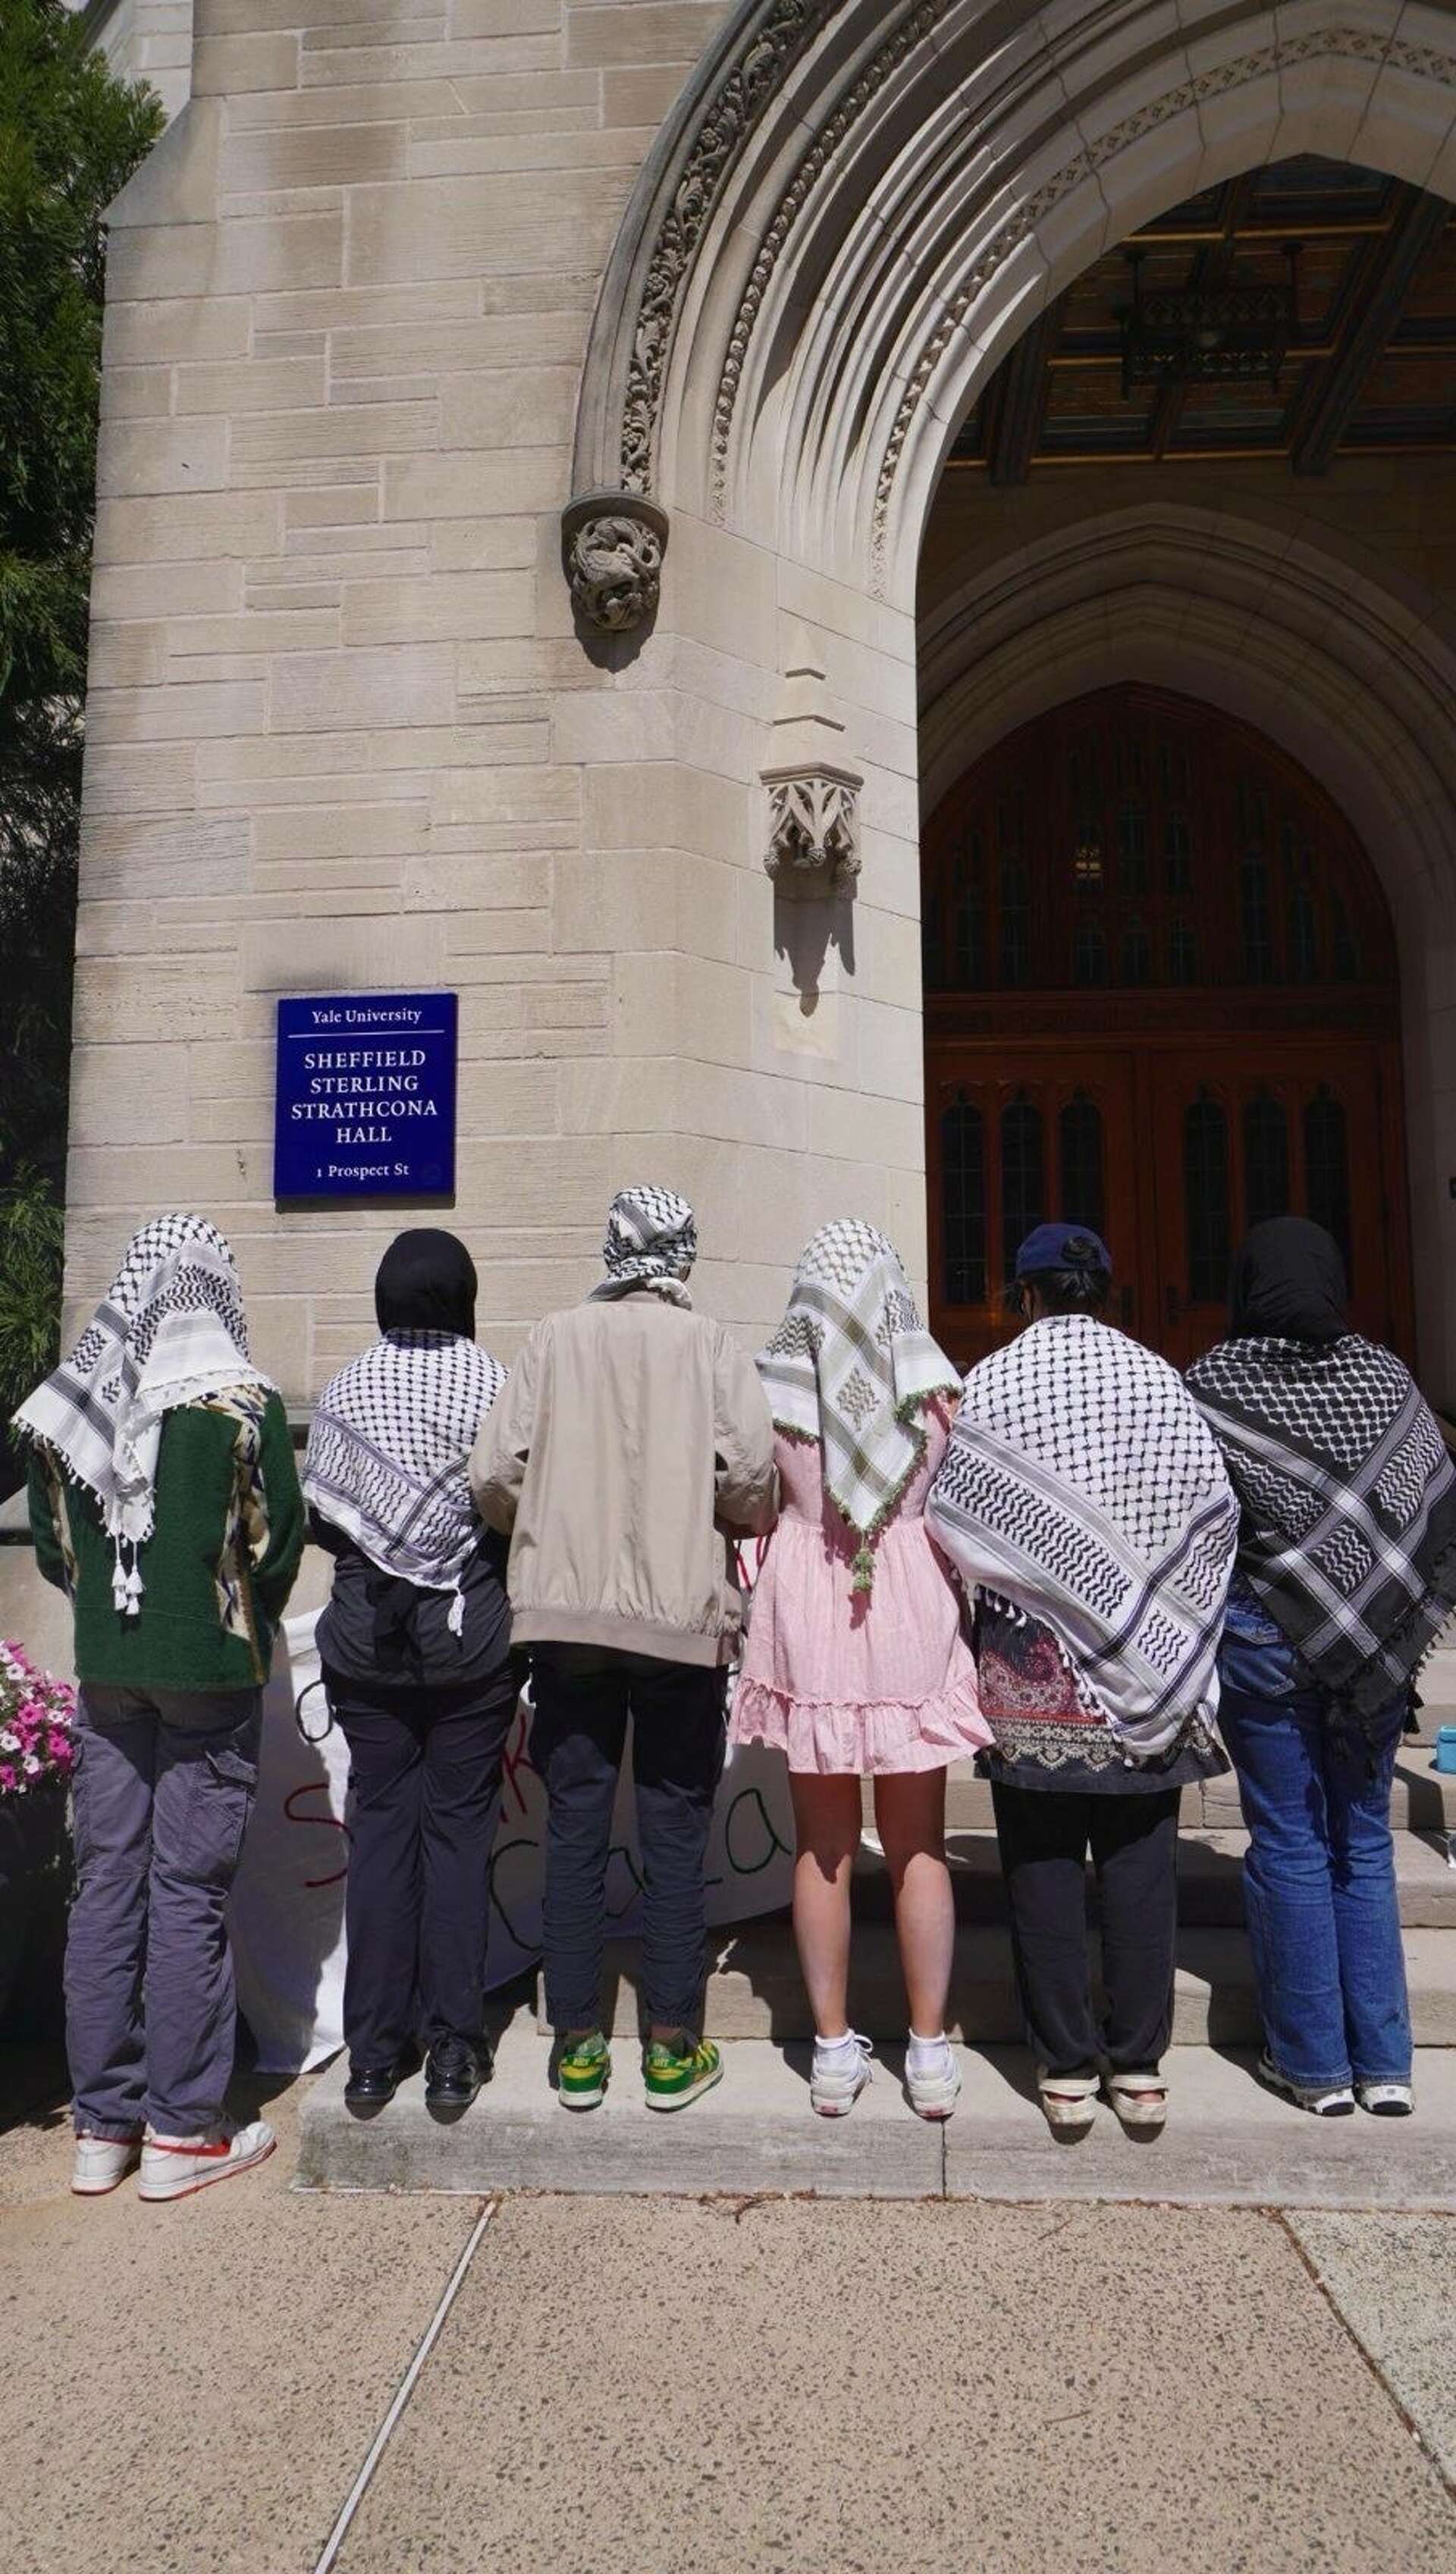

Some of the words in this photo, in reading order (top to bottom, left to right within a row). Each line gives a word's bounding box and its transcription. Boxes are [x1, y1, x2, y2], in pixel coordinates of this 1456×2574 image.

[312, 1009, 342, 1024] Yale
[345, 1007, 422, 1025] University
[304, 1050, 426, 1069] SHEFFIELD
[310, 1075, 419, 1094] STERLING
[291, 1099, 438, 1120] STRATHCONA
[335, 1126, 392, 1144] HALL
[328, 1165, 390, 1180] Prospect
[394, 1163, 410, 1176] St
